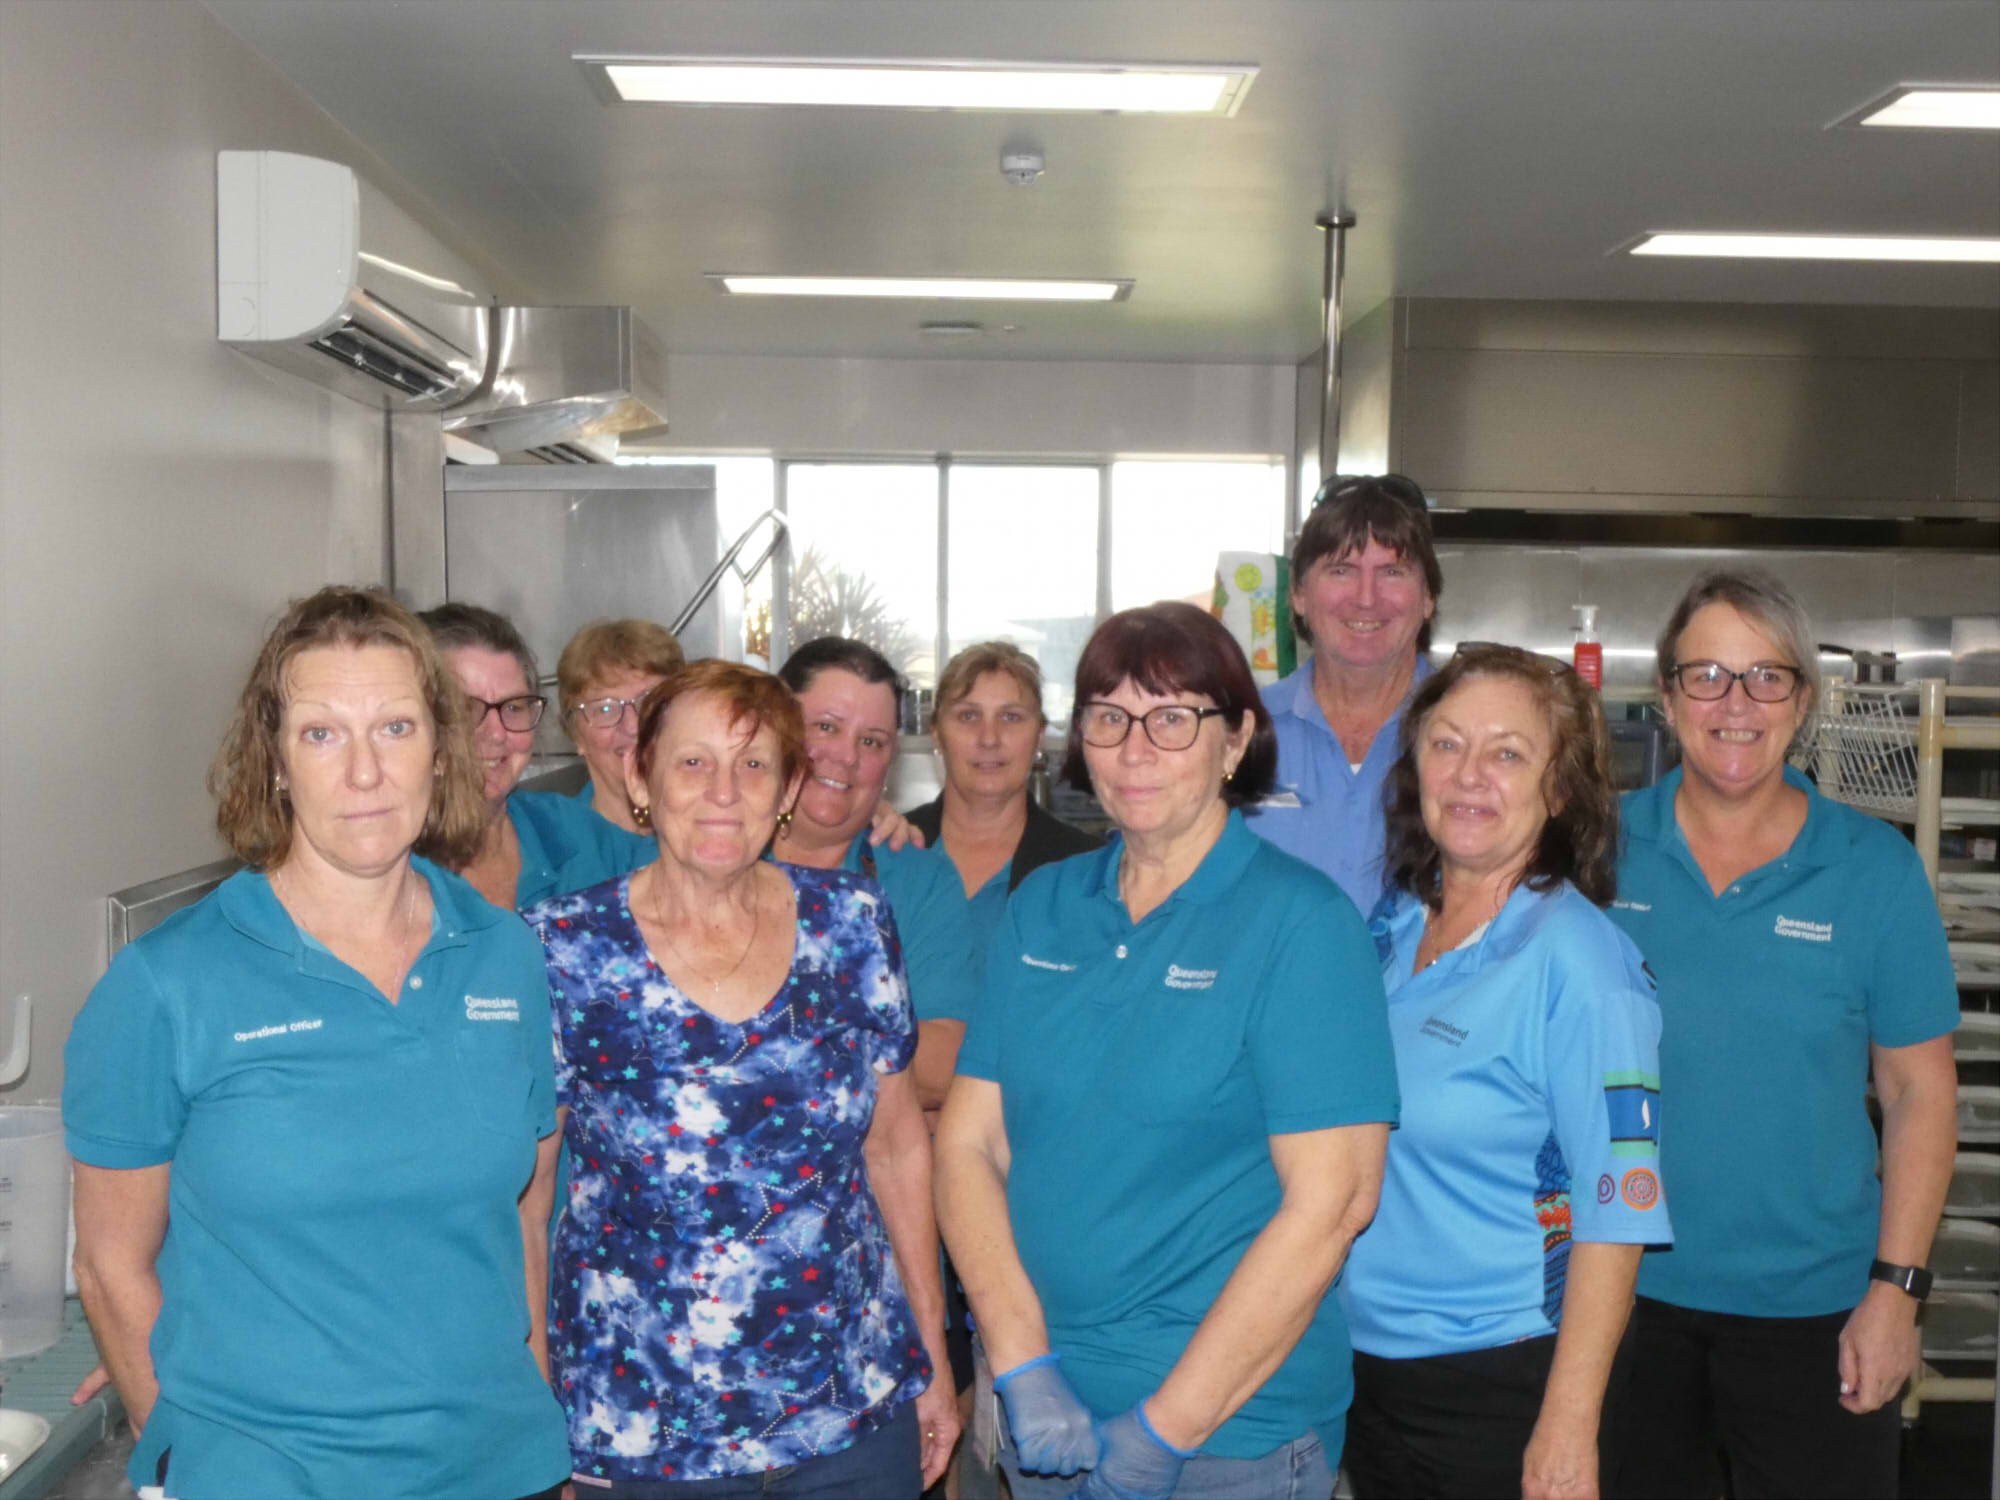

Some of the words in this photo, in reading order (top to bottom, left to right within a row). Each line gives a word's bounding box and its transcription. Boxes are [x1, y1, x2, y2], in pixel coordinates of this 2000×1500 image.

[1776, 914, 1832, 932] Queensland
[1774, 925, 1832, 942] Government
[234, 1025, 288, 1042] Operational
[290, 1020, 323, 1033] Officer
